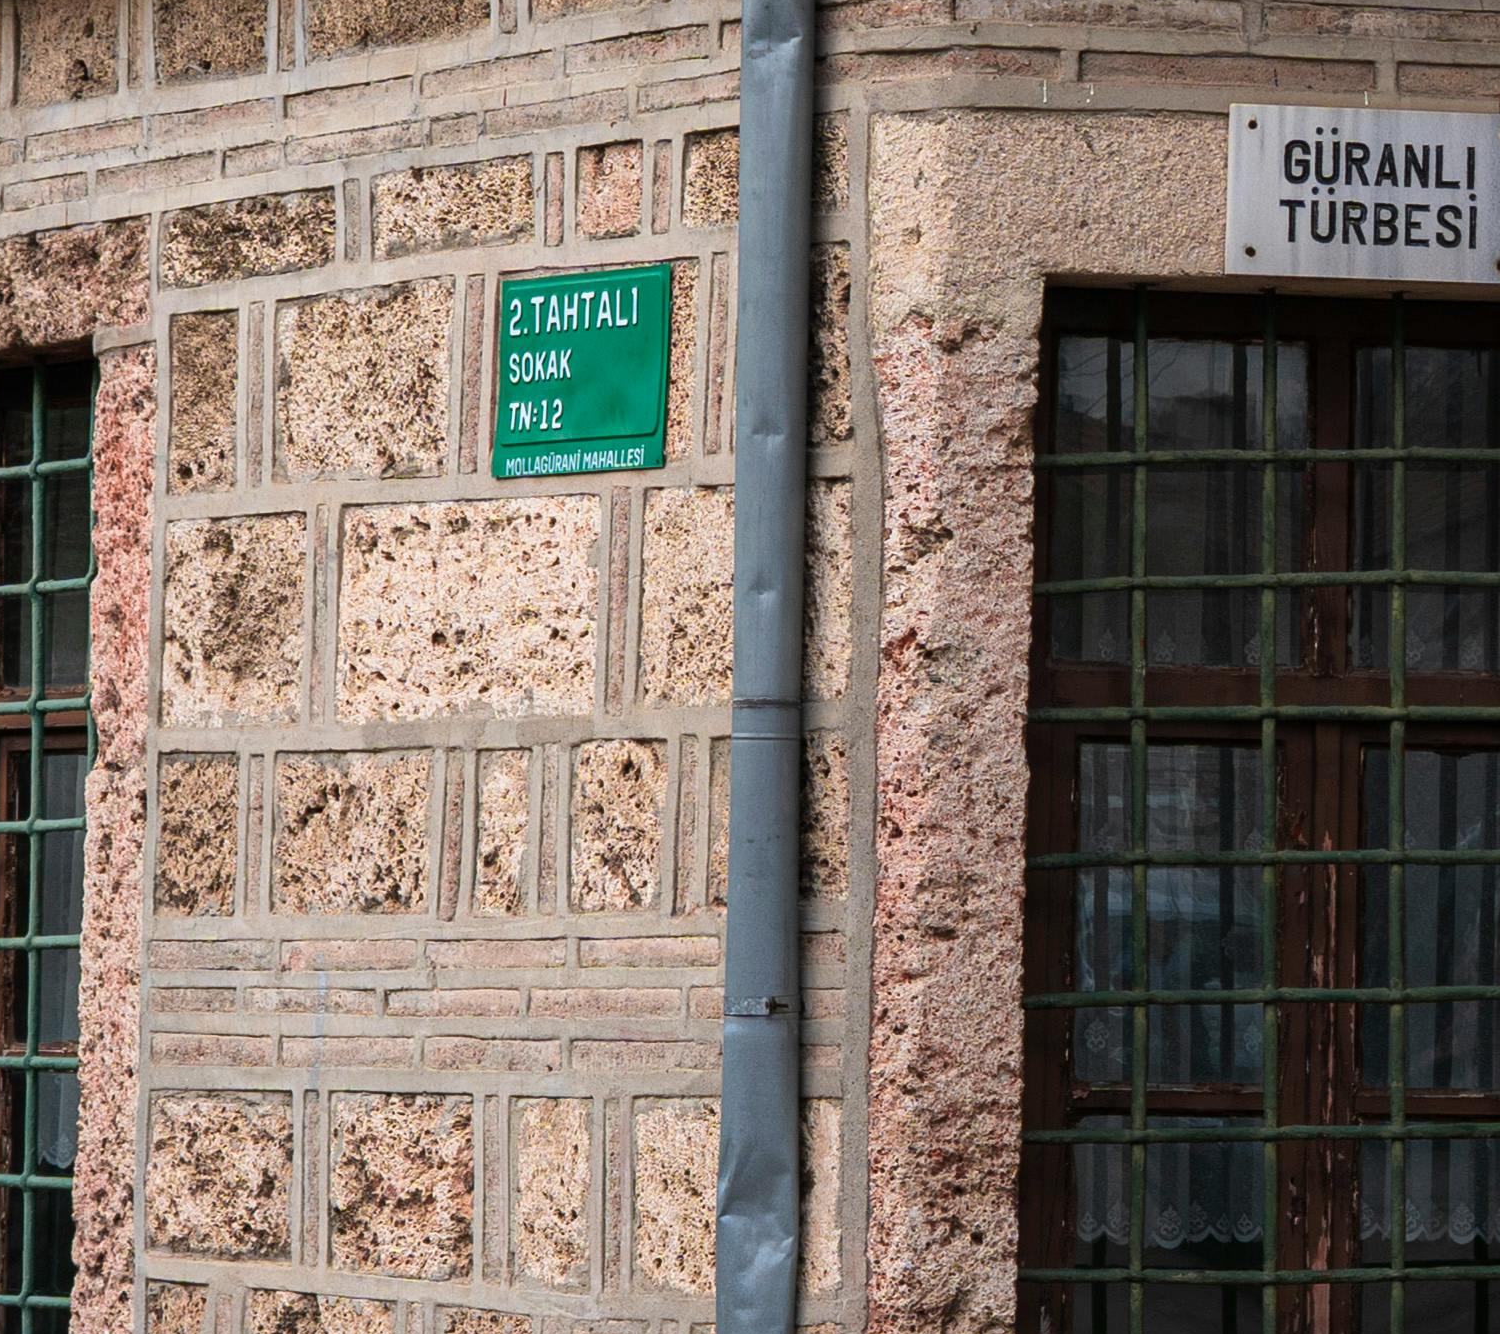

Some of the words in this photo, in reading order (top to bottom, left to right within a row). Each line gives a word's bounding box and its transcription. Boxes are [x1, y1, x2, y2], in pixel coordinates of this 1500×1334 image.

[1284, 126, 1476, 190] GÜRANLI
[1279, 186, 1478, 250] TÜRBESİ
[509, 286, 639, 337] 2.TAHTALI
[508, 348, 572, 384] SOKAK
[508, 398, 564, 432] TN:12
[505, 448, 581, 476] MOLLAGÜRANİ
[582, 444, 645, 469] MAHALLESİ
